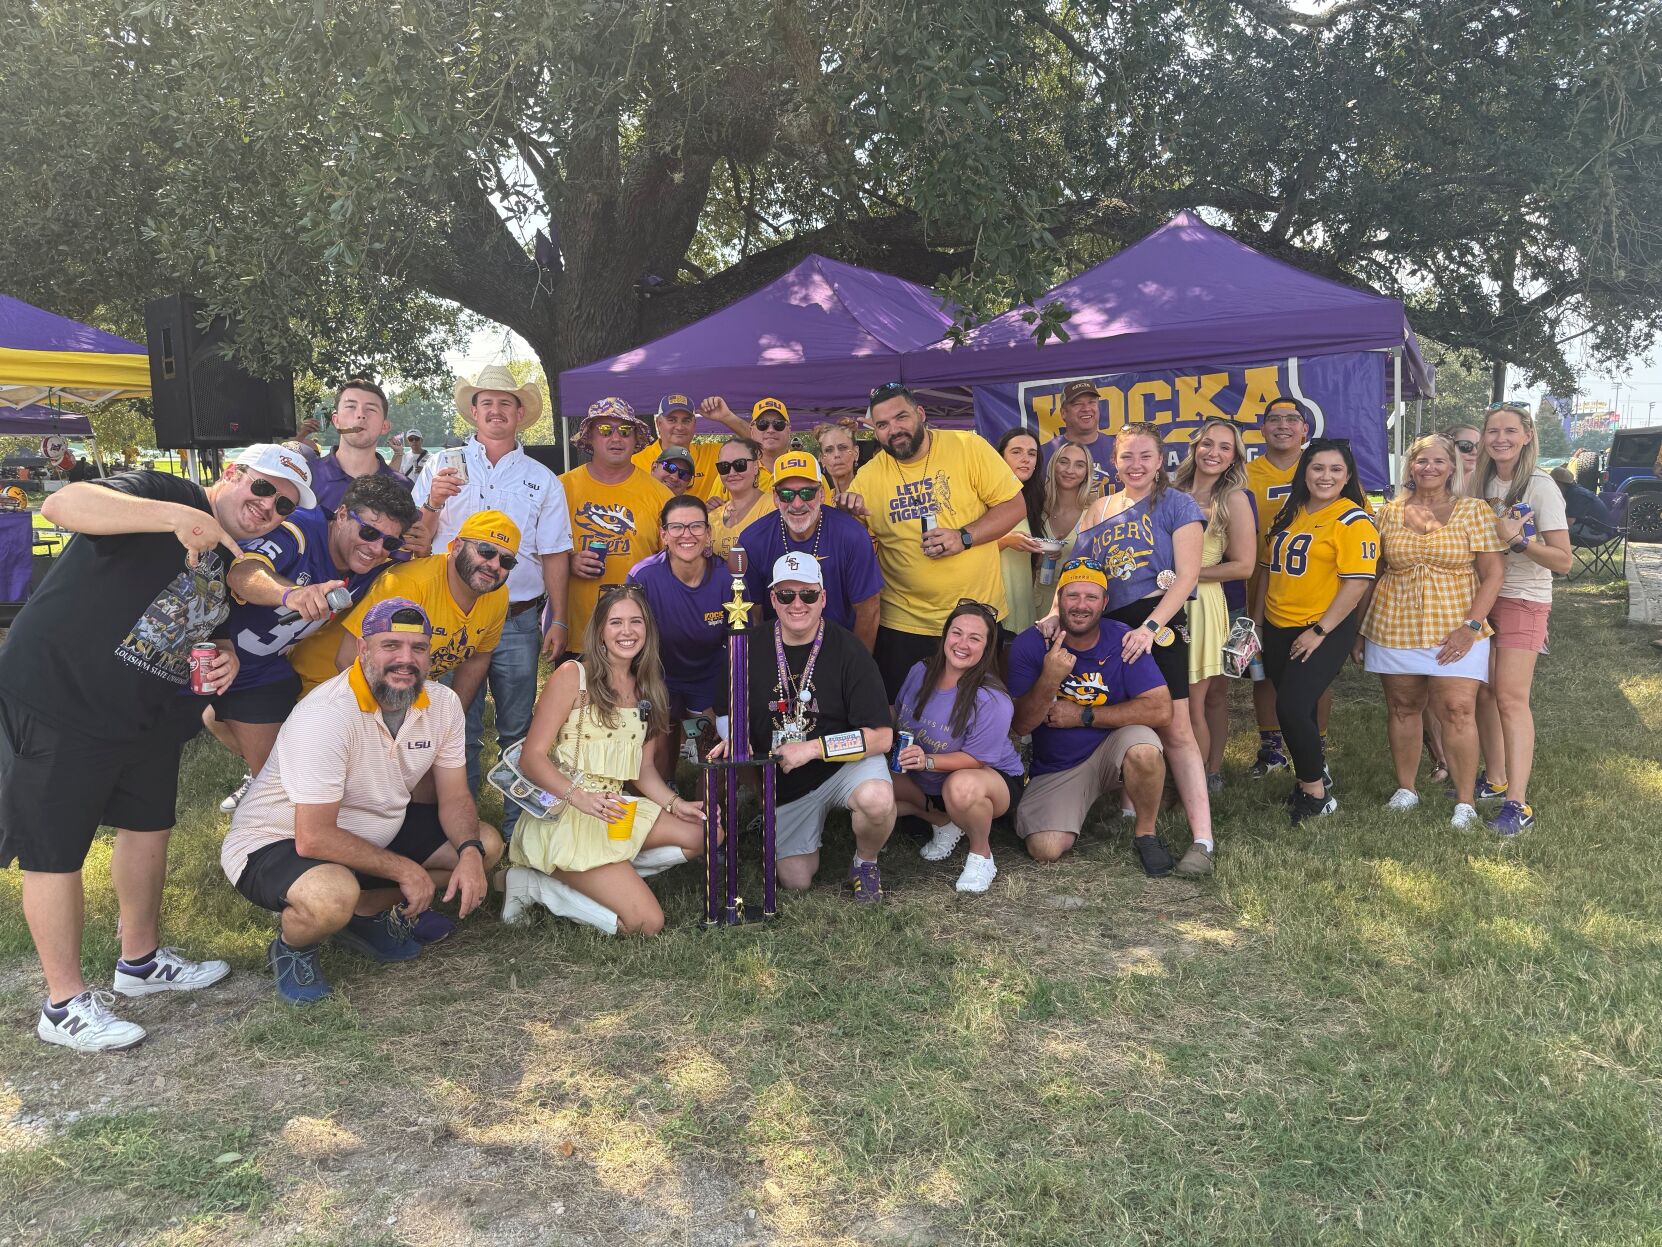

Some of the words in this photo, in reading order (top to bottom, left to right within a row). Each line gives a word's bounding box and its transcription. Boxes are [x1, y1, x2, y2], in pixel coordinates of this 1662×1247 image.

[759, 401, 781, 410] LSU
[1033, 365, 1283, 446] KOCKA
[781, 459, 807, 470] LSU
[523, 479, 540, 491] LSU
[896, 477, 933, 496] LET'S
[889, 503, 938, 524] TIGERS
[489, 529, 511, 544] LSU
[579, 534, 631, 553] Ters
[1269, 529, 1314, 578] 18
[1360, 540, 1377, 560] 18
[784, 555, 800, 571] LSU
[120, 632, 158, 662] LSU
[114, 647, 152, 671] LOUISIANA
[149, 665, 169, 679] STATE
[407, 740, 431, 750] LSU
[155, 963, 183, 982] N
[62, 1015, 89, 1037] N
